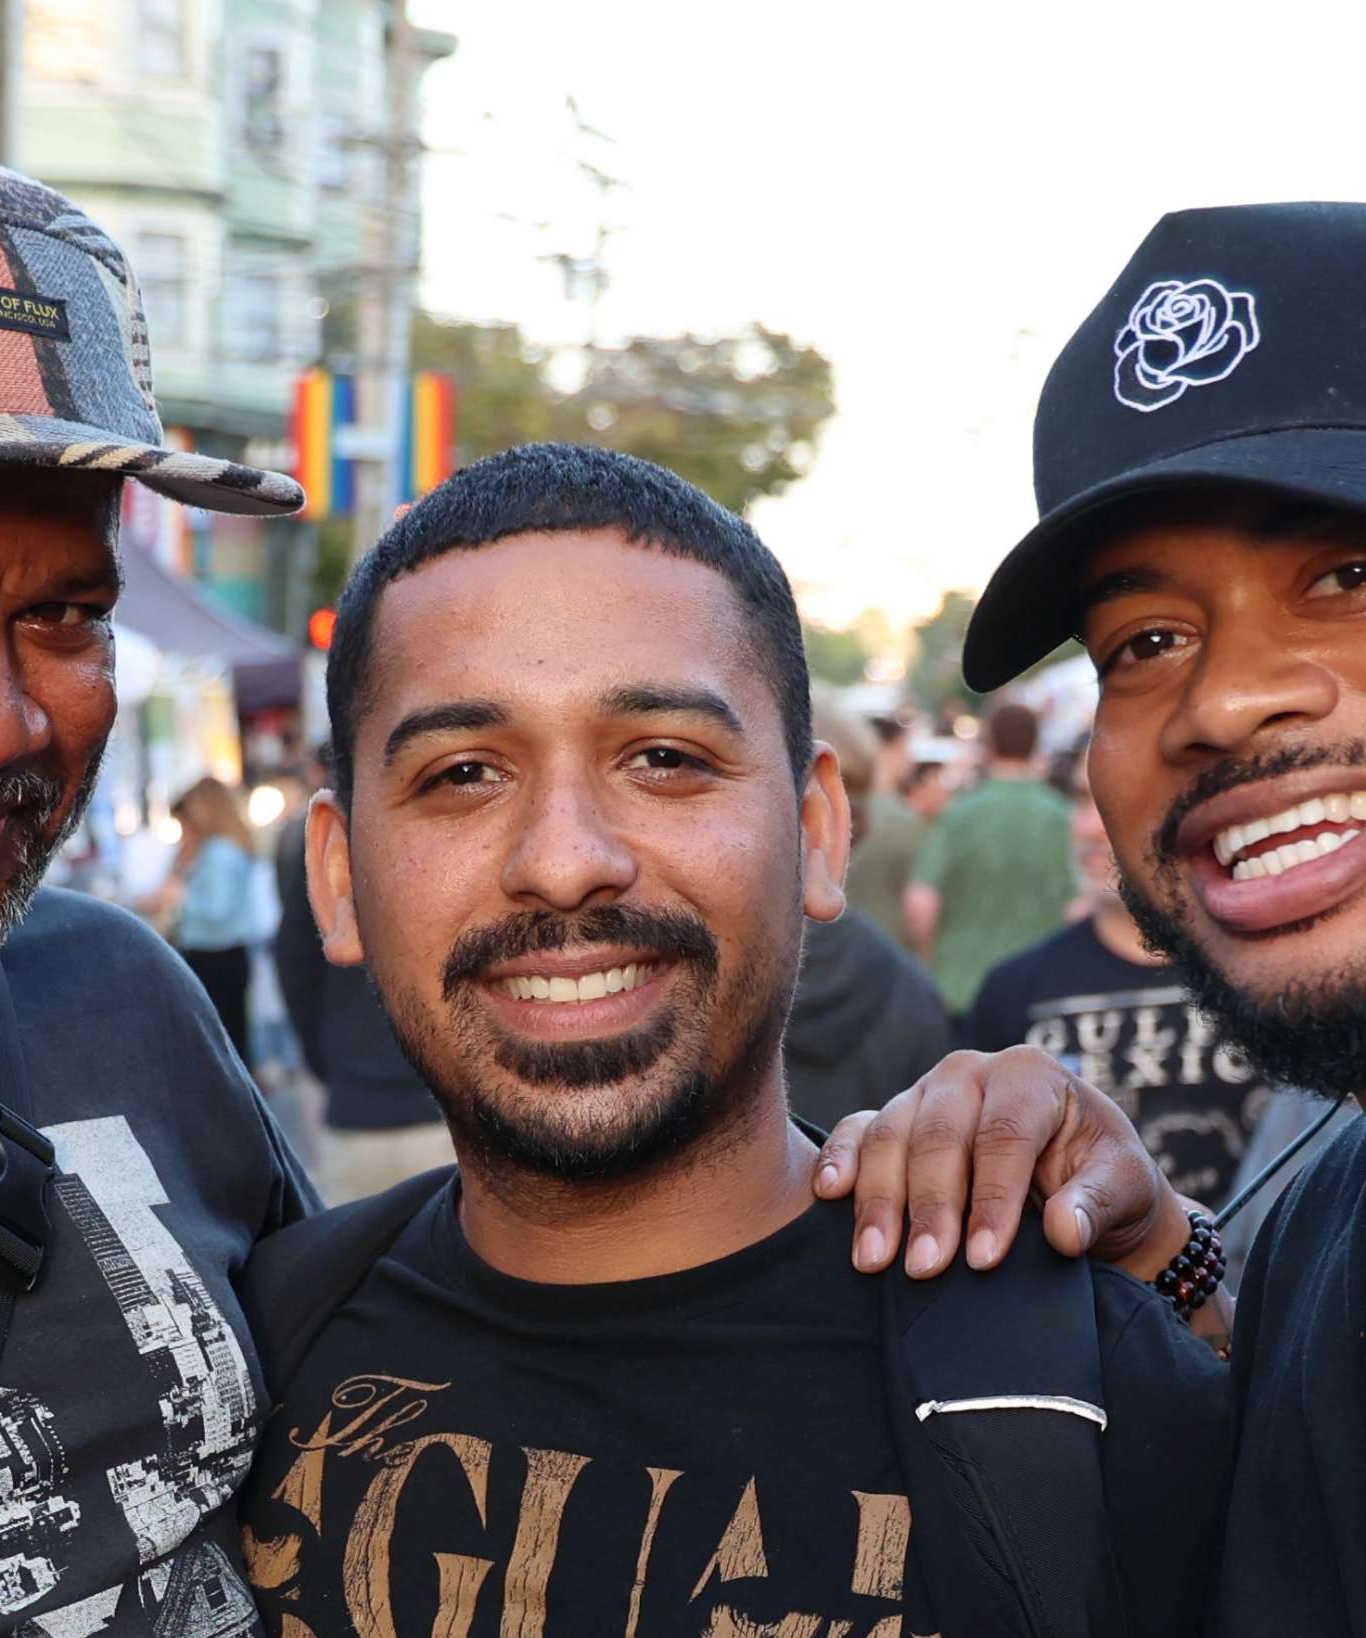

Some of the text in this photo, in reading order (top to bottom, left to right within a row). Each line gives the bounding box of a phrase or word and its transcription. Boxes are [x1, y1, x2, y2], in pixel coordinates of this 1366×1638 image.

[0, 296, 21, 310] OF
[24, 300, 60, 320] FLUX
[289, 1373, 452, 1462] The
